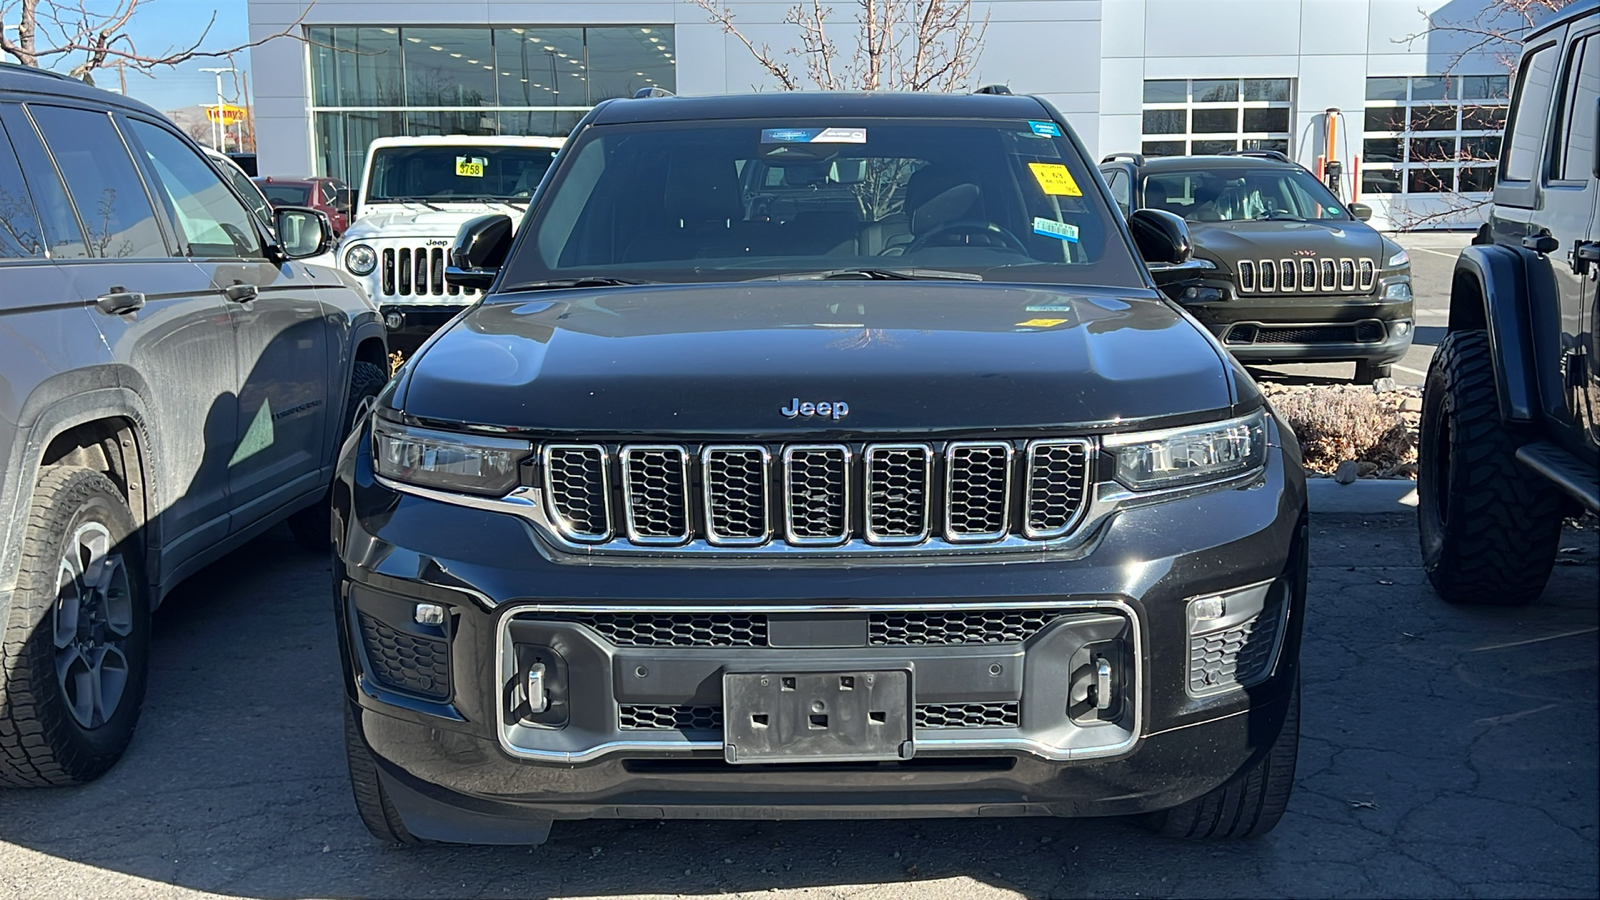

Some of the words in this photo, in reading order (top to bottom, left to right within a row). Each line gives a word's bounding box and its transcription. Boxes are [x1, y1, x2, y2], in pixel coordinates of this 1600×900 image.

[459, 164, 480, 175] 3758
[426, 239, 448, 247] Jeep
[781, 397, 849, 420] Jeep
